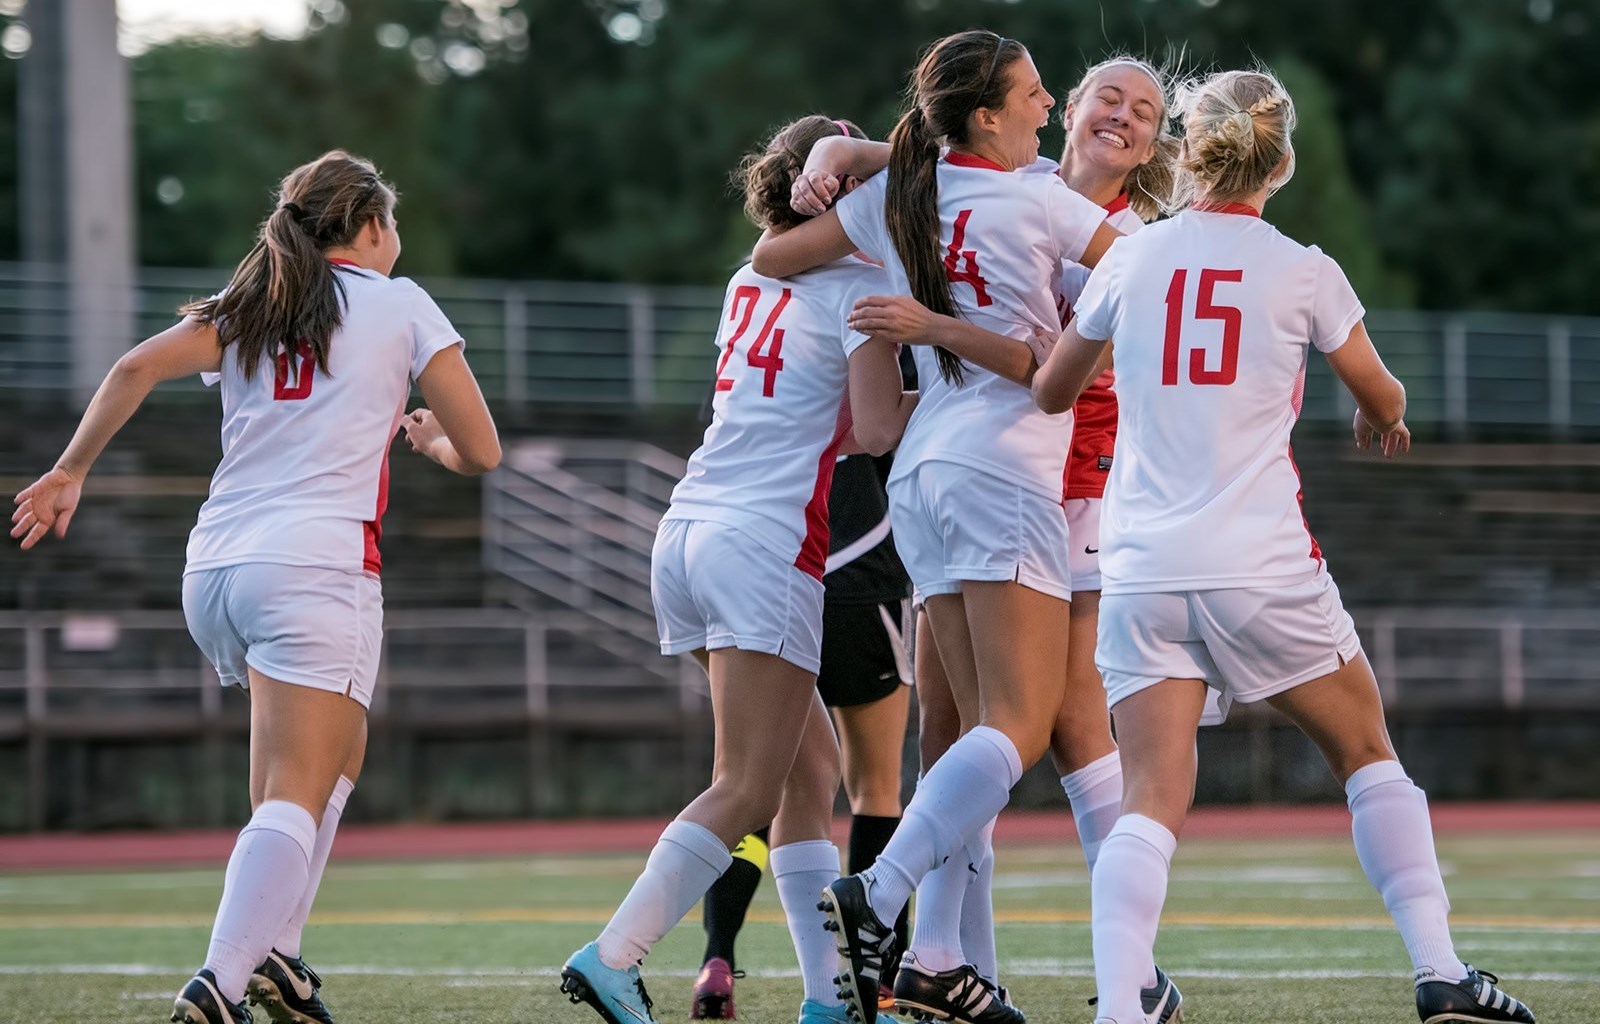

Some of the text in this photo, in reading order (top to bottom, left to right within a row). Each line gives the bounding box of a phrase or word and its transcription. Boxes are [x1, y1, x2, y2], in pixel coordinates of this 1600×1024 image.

[943, 209, 993, 307] 4
[715, 285, 792, 398] 24
[1161, 268, 1244, 386] 15
